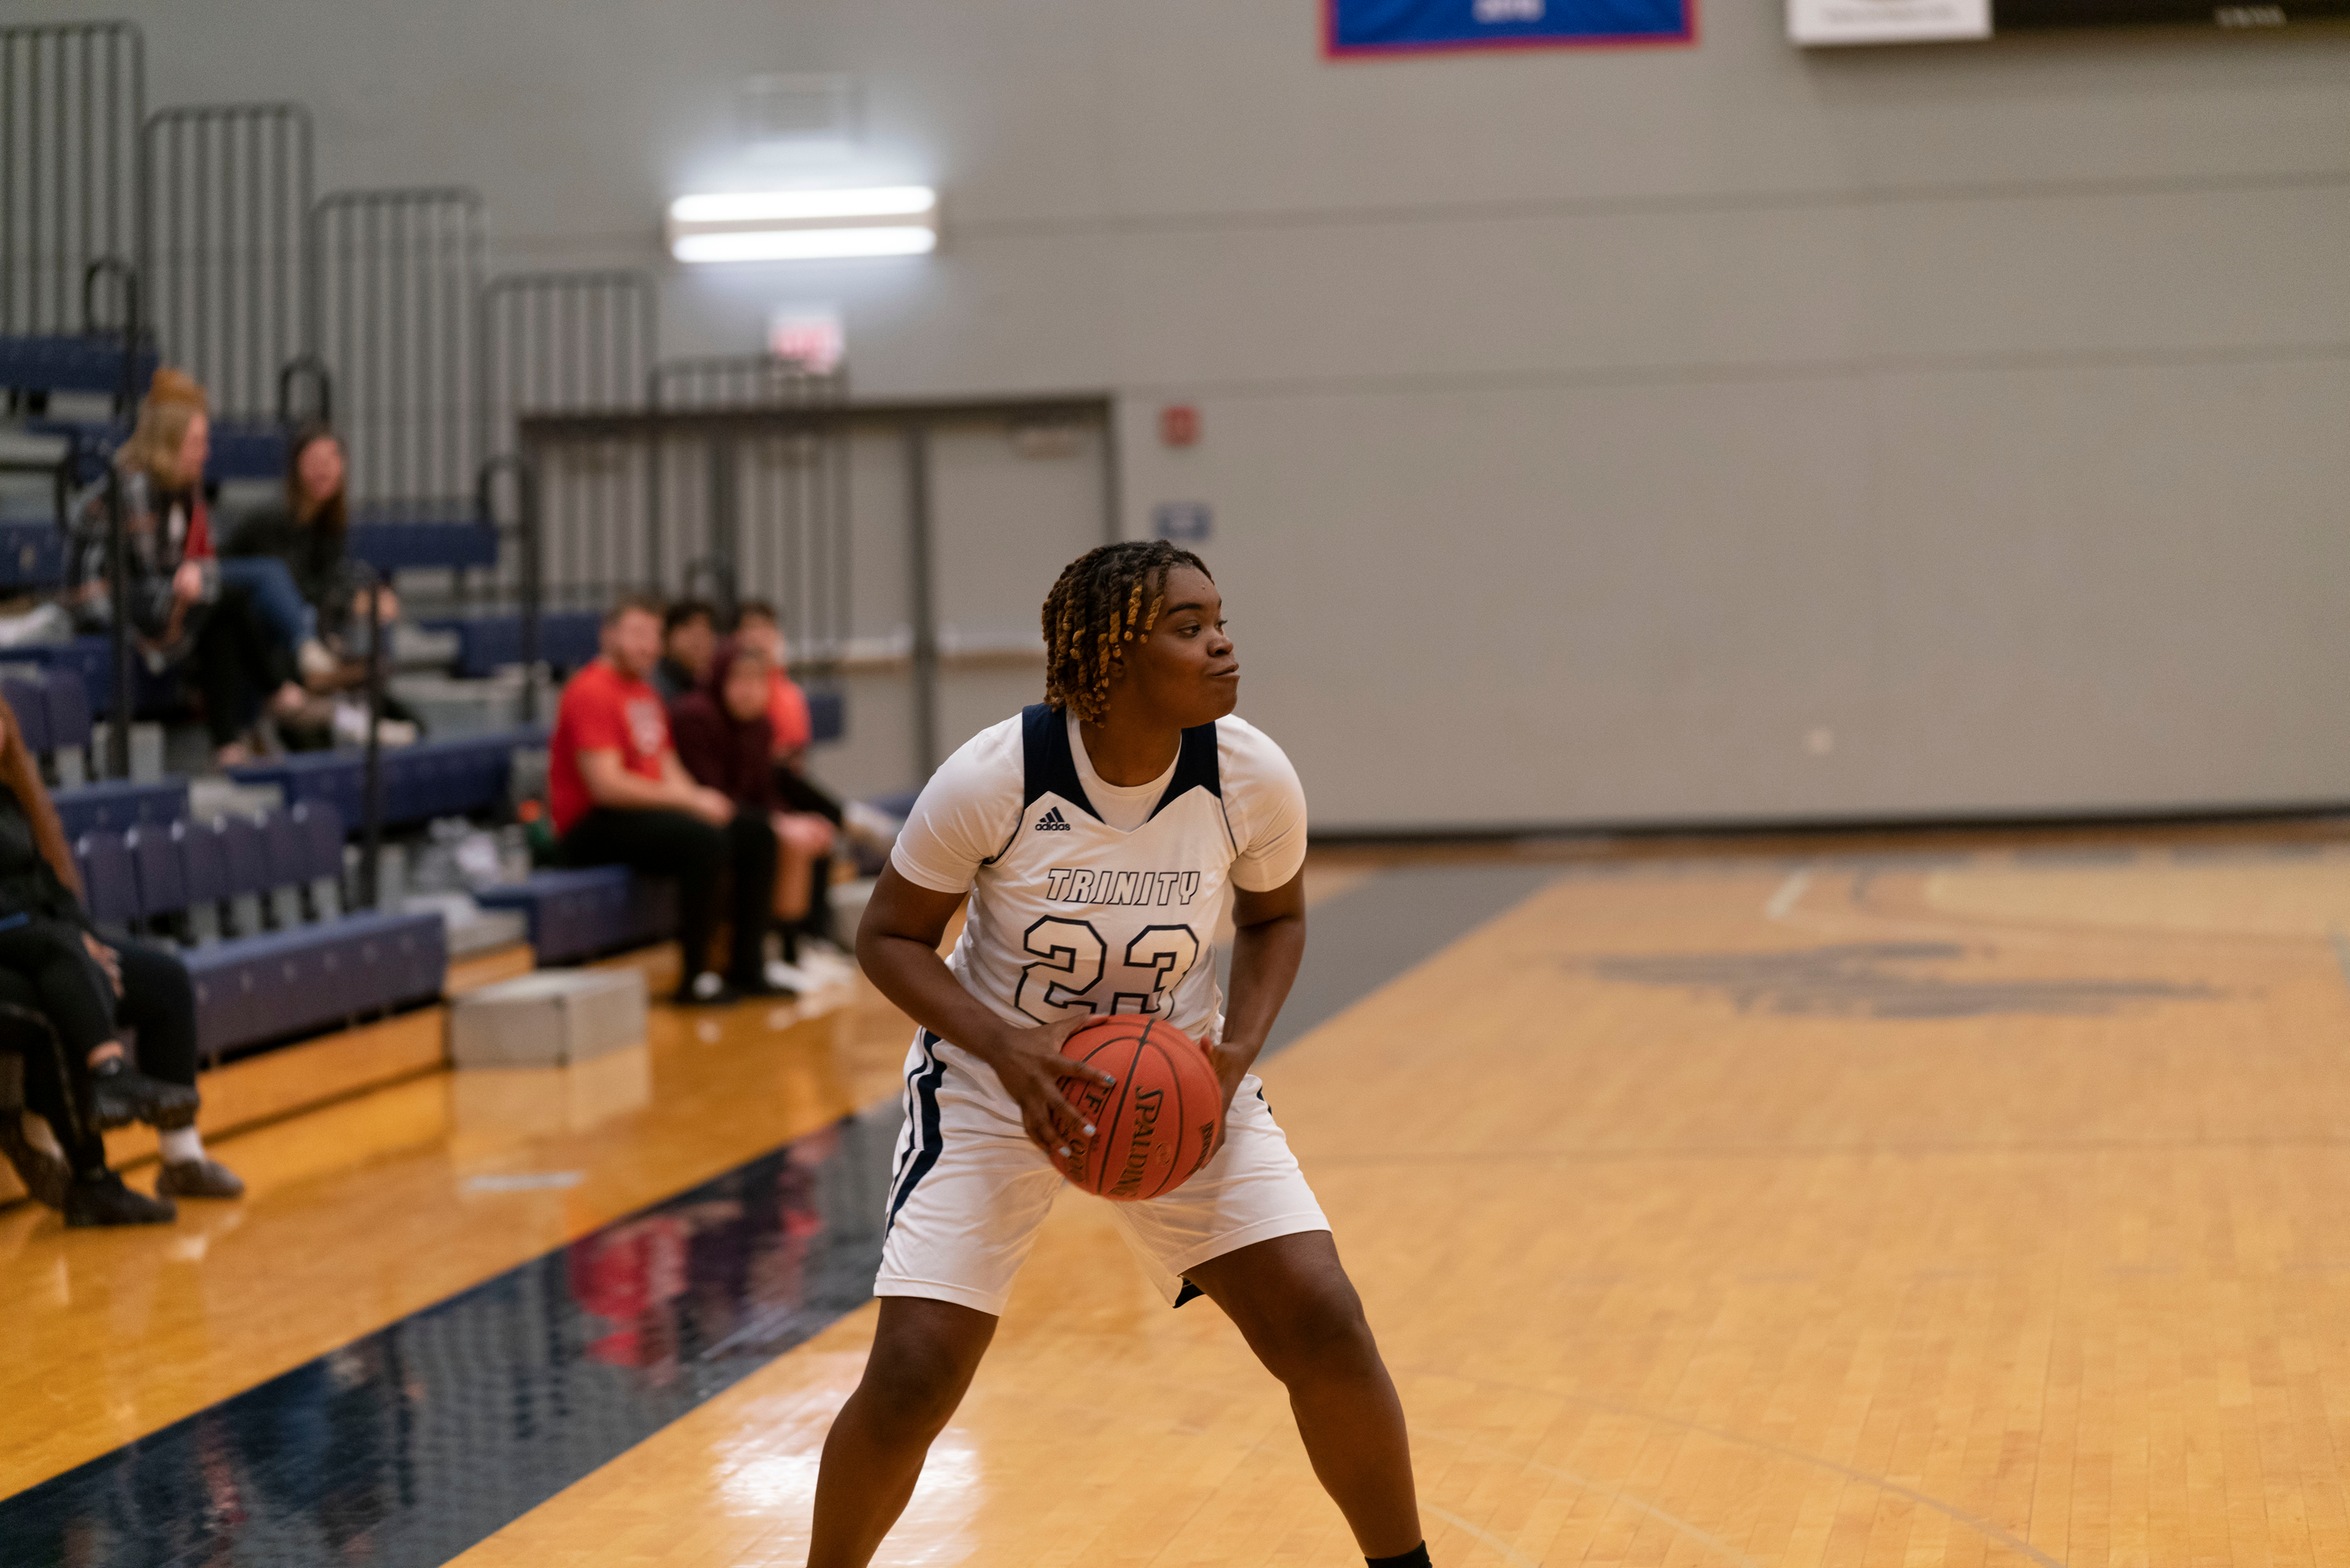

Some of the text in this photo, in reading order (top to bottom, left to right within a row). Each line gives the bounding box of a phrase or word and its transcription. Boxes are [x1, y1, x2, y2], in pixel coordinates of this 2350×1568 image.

[1035, 821, 1071, 831] adidas
[1046, 868, 1201, 906] TRINITY
[1014, 914, 1200, 1025] 23
